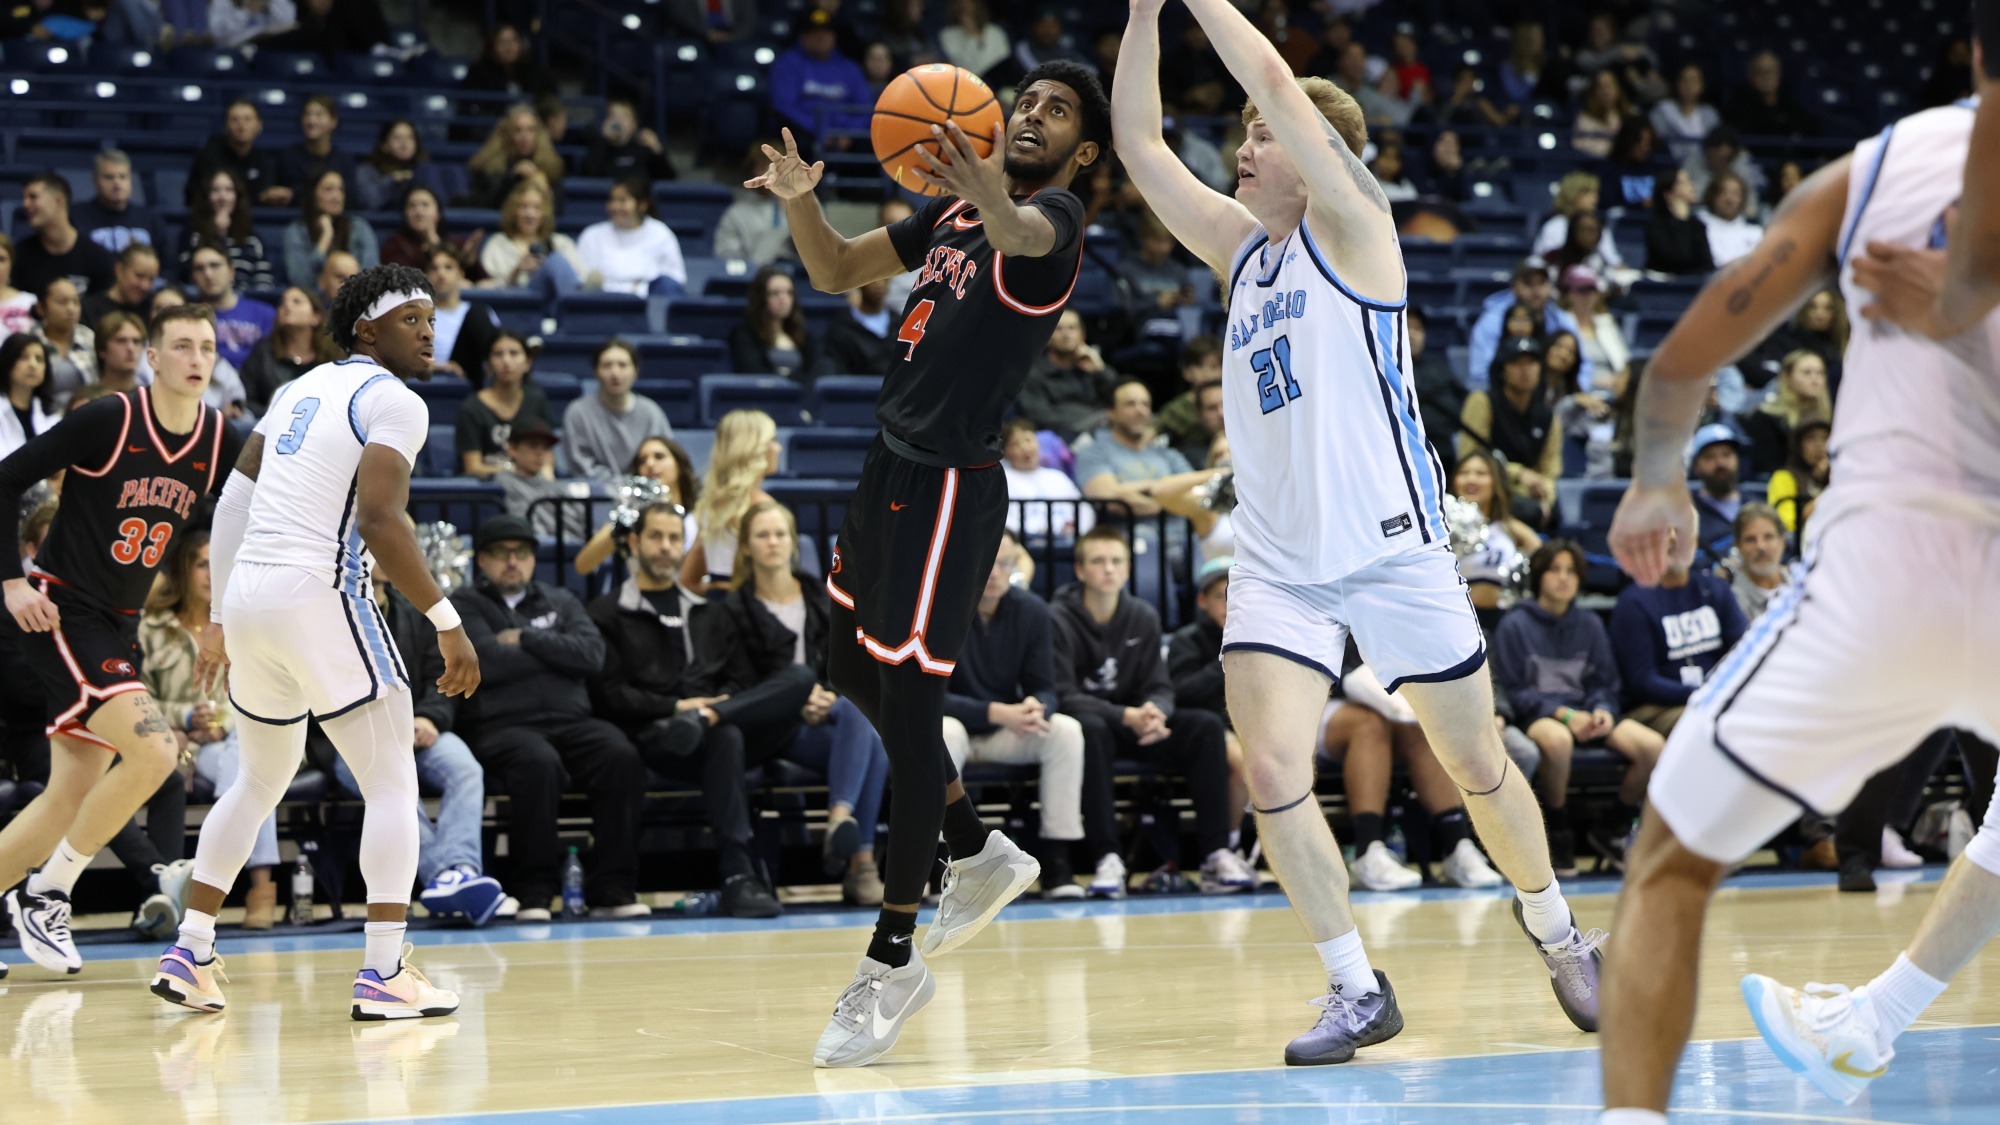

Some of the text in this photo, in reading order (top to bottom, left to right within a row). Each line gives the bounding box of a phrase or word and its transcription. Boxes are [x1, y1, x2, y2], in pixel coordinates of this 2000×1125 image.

[897, 298, 935, 362] 4
[1250, 334, 1303, 415] 21
[275, 396, 321, 455] 3
[116, 476, 197, 520] PACIFIC
[111, 517, 173, 568] 33
